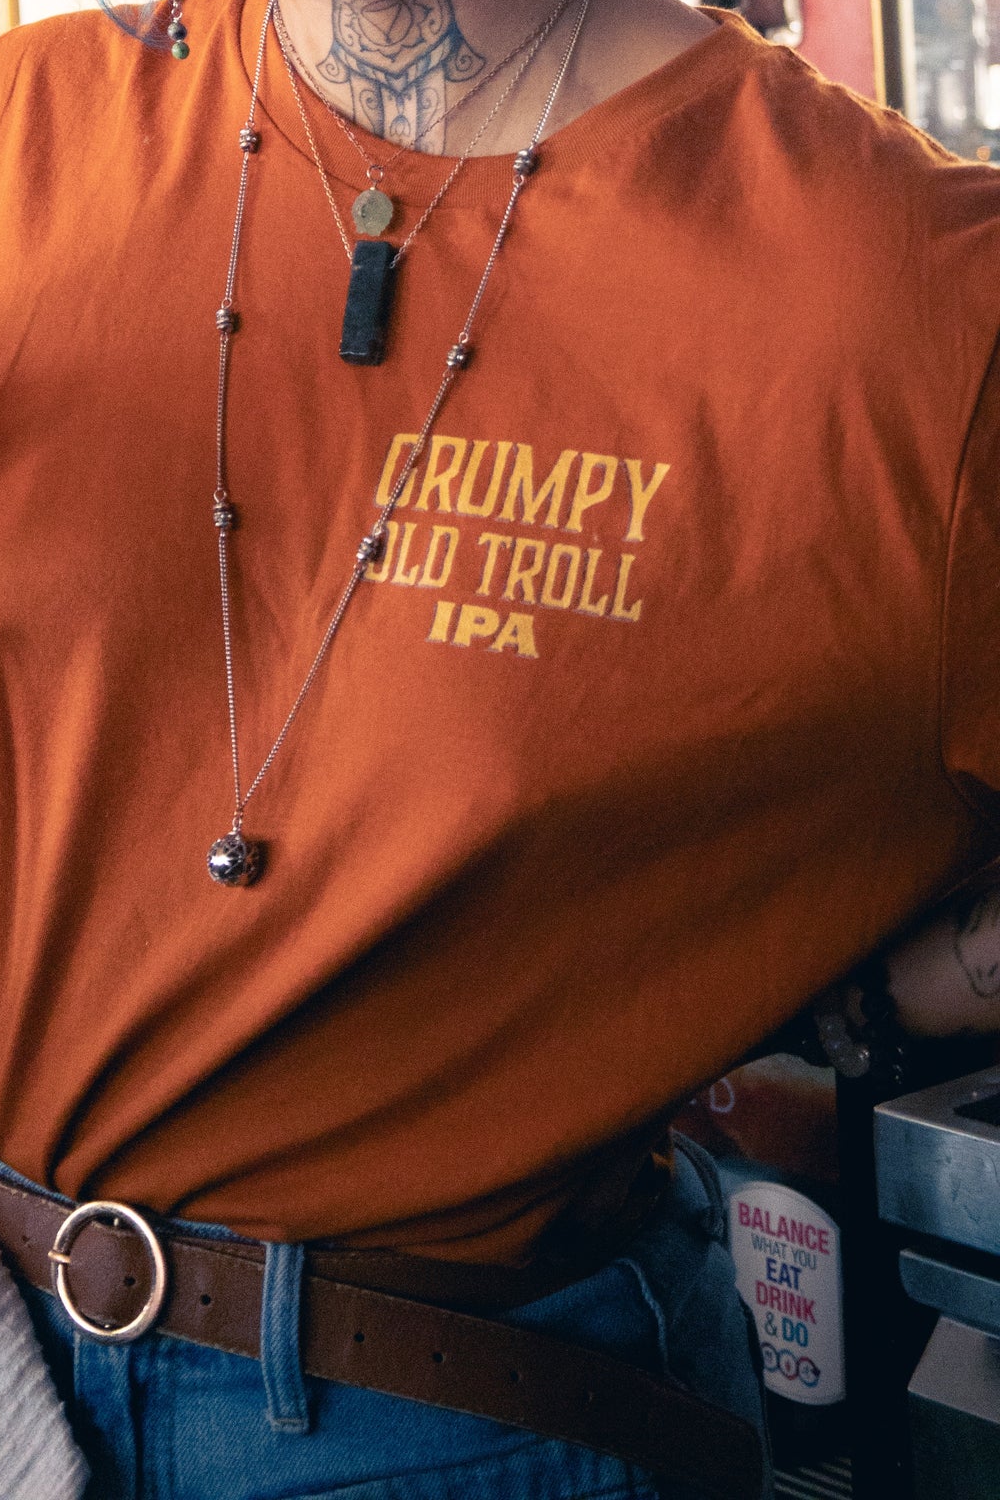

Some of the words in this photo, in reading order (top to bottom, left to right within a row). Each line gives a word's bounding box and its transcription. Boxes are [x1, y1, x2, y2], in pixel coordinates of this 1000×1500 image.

[375, 432, 672, 543] GRUMPY
[475, 531, 643, 624] TROLL
[425, 599, 540, 660] IPA
[737, 1202, 830, 1256] BALANCE
[750, 1233, 793, 1261] WHAT
[791, 1246, 818, 1271] YOU
[765, 1256, 801, 1291] EAT
[754, 1280, 817, 1325] DRINK
[764, 1311, 779, 1339] &
[781, 1321, 809, 1348] DO
